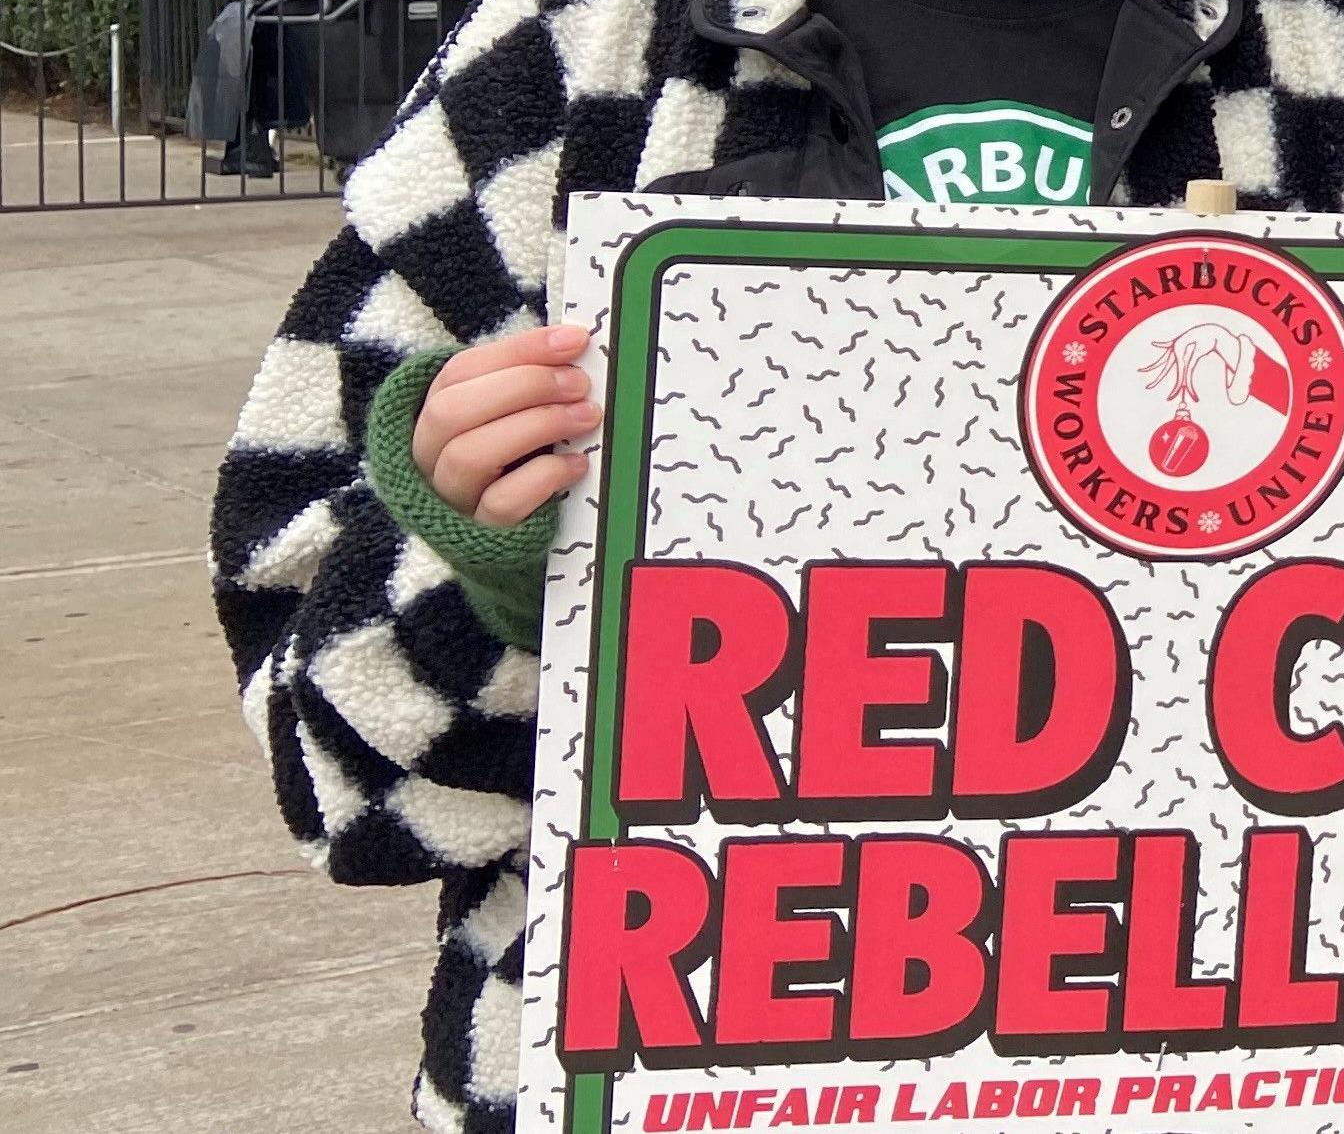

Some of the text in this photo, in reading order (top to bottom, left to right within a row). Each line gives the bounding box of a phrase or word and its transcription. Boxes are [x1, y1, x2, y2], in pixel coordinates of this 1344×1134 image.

[1078, 261, 1324, 347] STARBUCKS
[1053, 370, 1190, 535] WORKERS
[1226, 378, 1335, 527] UNITED
[616, 560, 1130, 818] RED
[642, 1084, 882, 1133] UNFAIR
[890, 1078, 1102, 1122] LABOR
